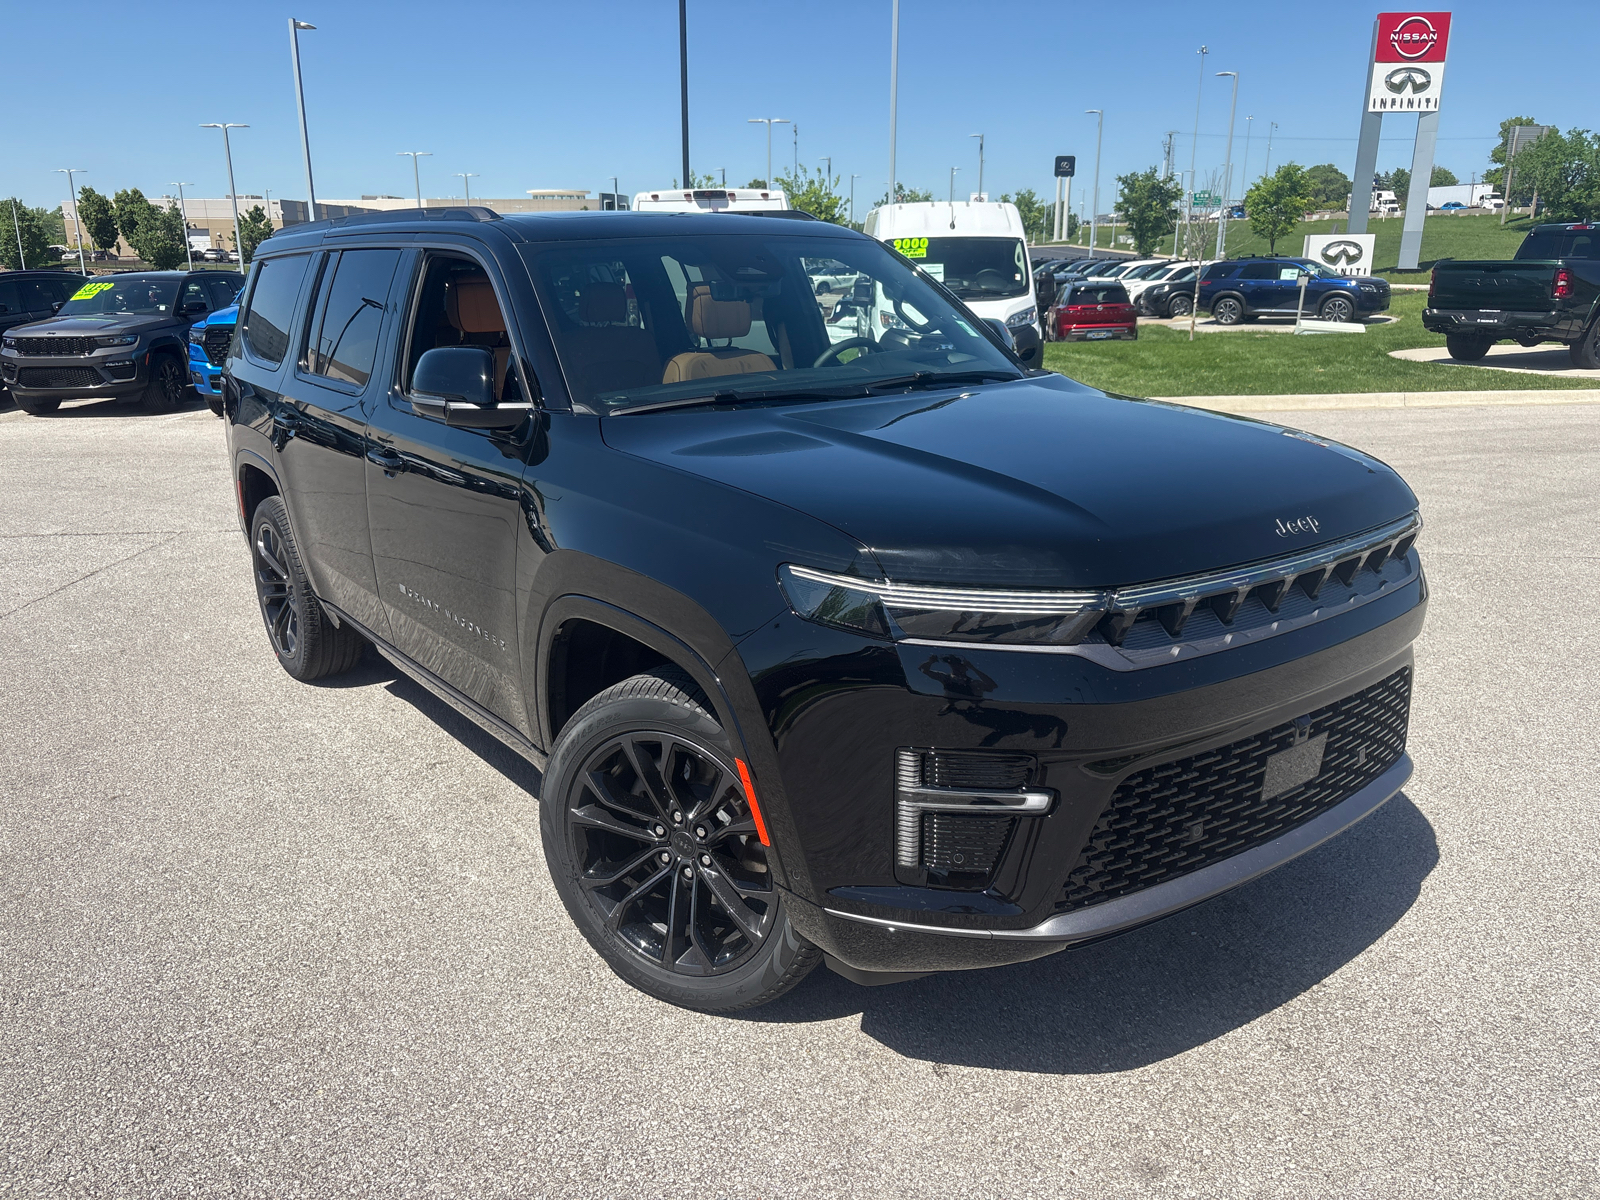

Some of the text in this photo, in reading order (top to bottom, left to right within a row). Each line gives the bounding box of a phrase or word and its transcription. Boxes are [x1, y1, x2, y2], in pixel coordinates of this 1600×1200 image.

[1390, 33, 1438, 41] NISSAN
[1372, 98, 1438, 109] INFINITI
[893, 237, 929, 250] 9000
[1335, 268, 1367, 276] INITI
[1275, 515, 1321, 538] Jeep
[408, 588, 506, 652] GRAND WAGONEER
